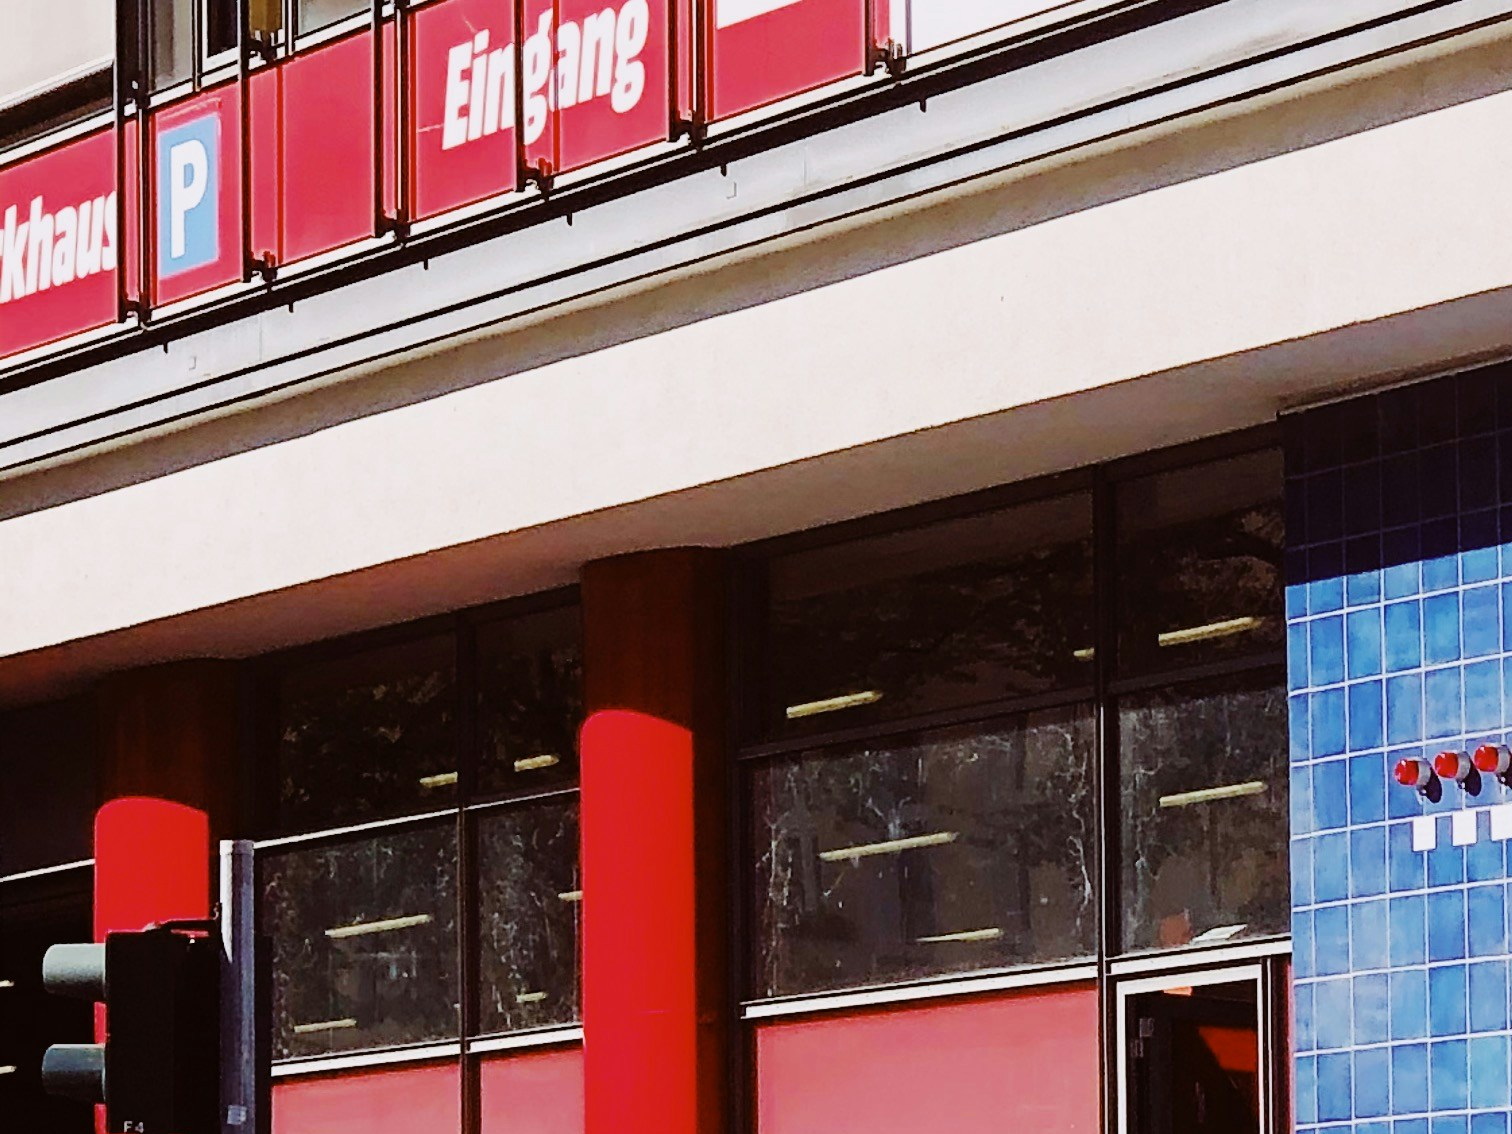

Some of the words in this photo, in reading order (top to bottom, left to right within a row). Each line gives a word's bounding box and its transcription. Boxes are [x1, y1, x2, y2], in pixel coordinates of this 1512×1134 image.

[442, 0, 650, 150] Eingang
[0, 190, 118, 304] khaus
[170, 139, 208, 259] P
